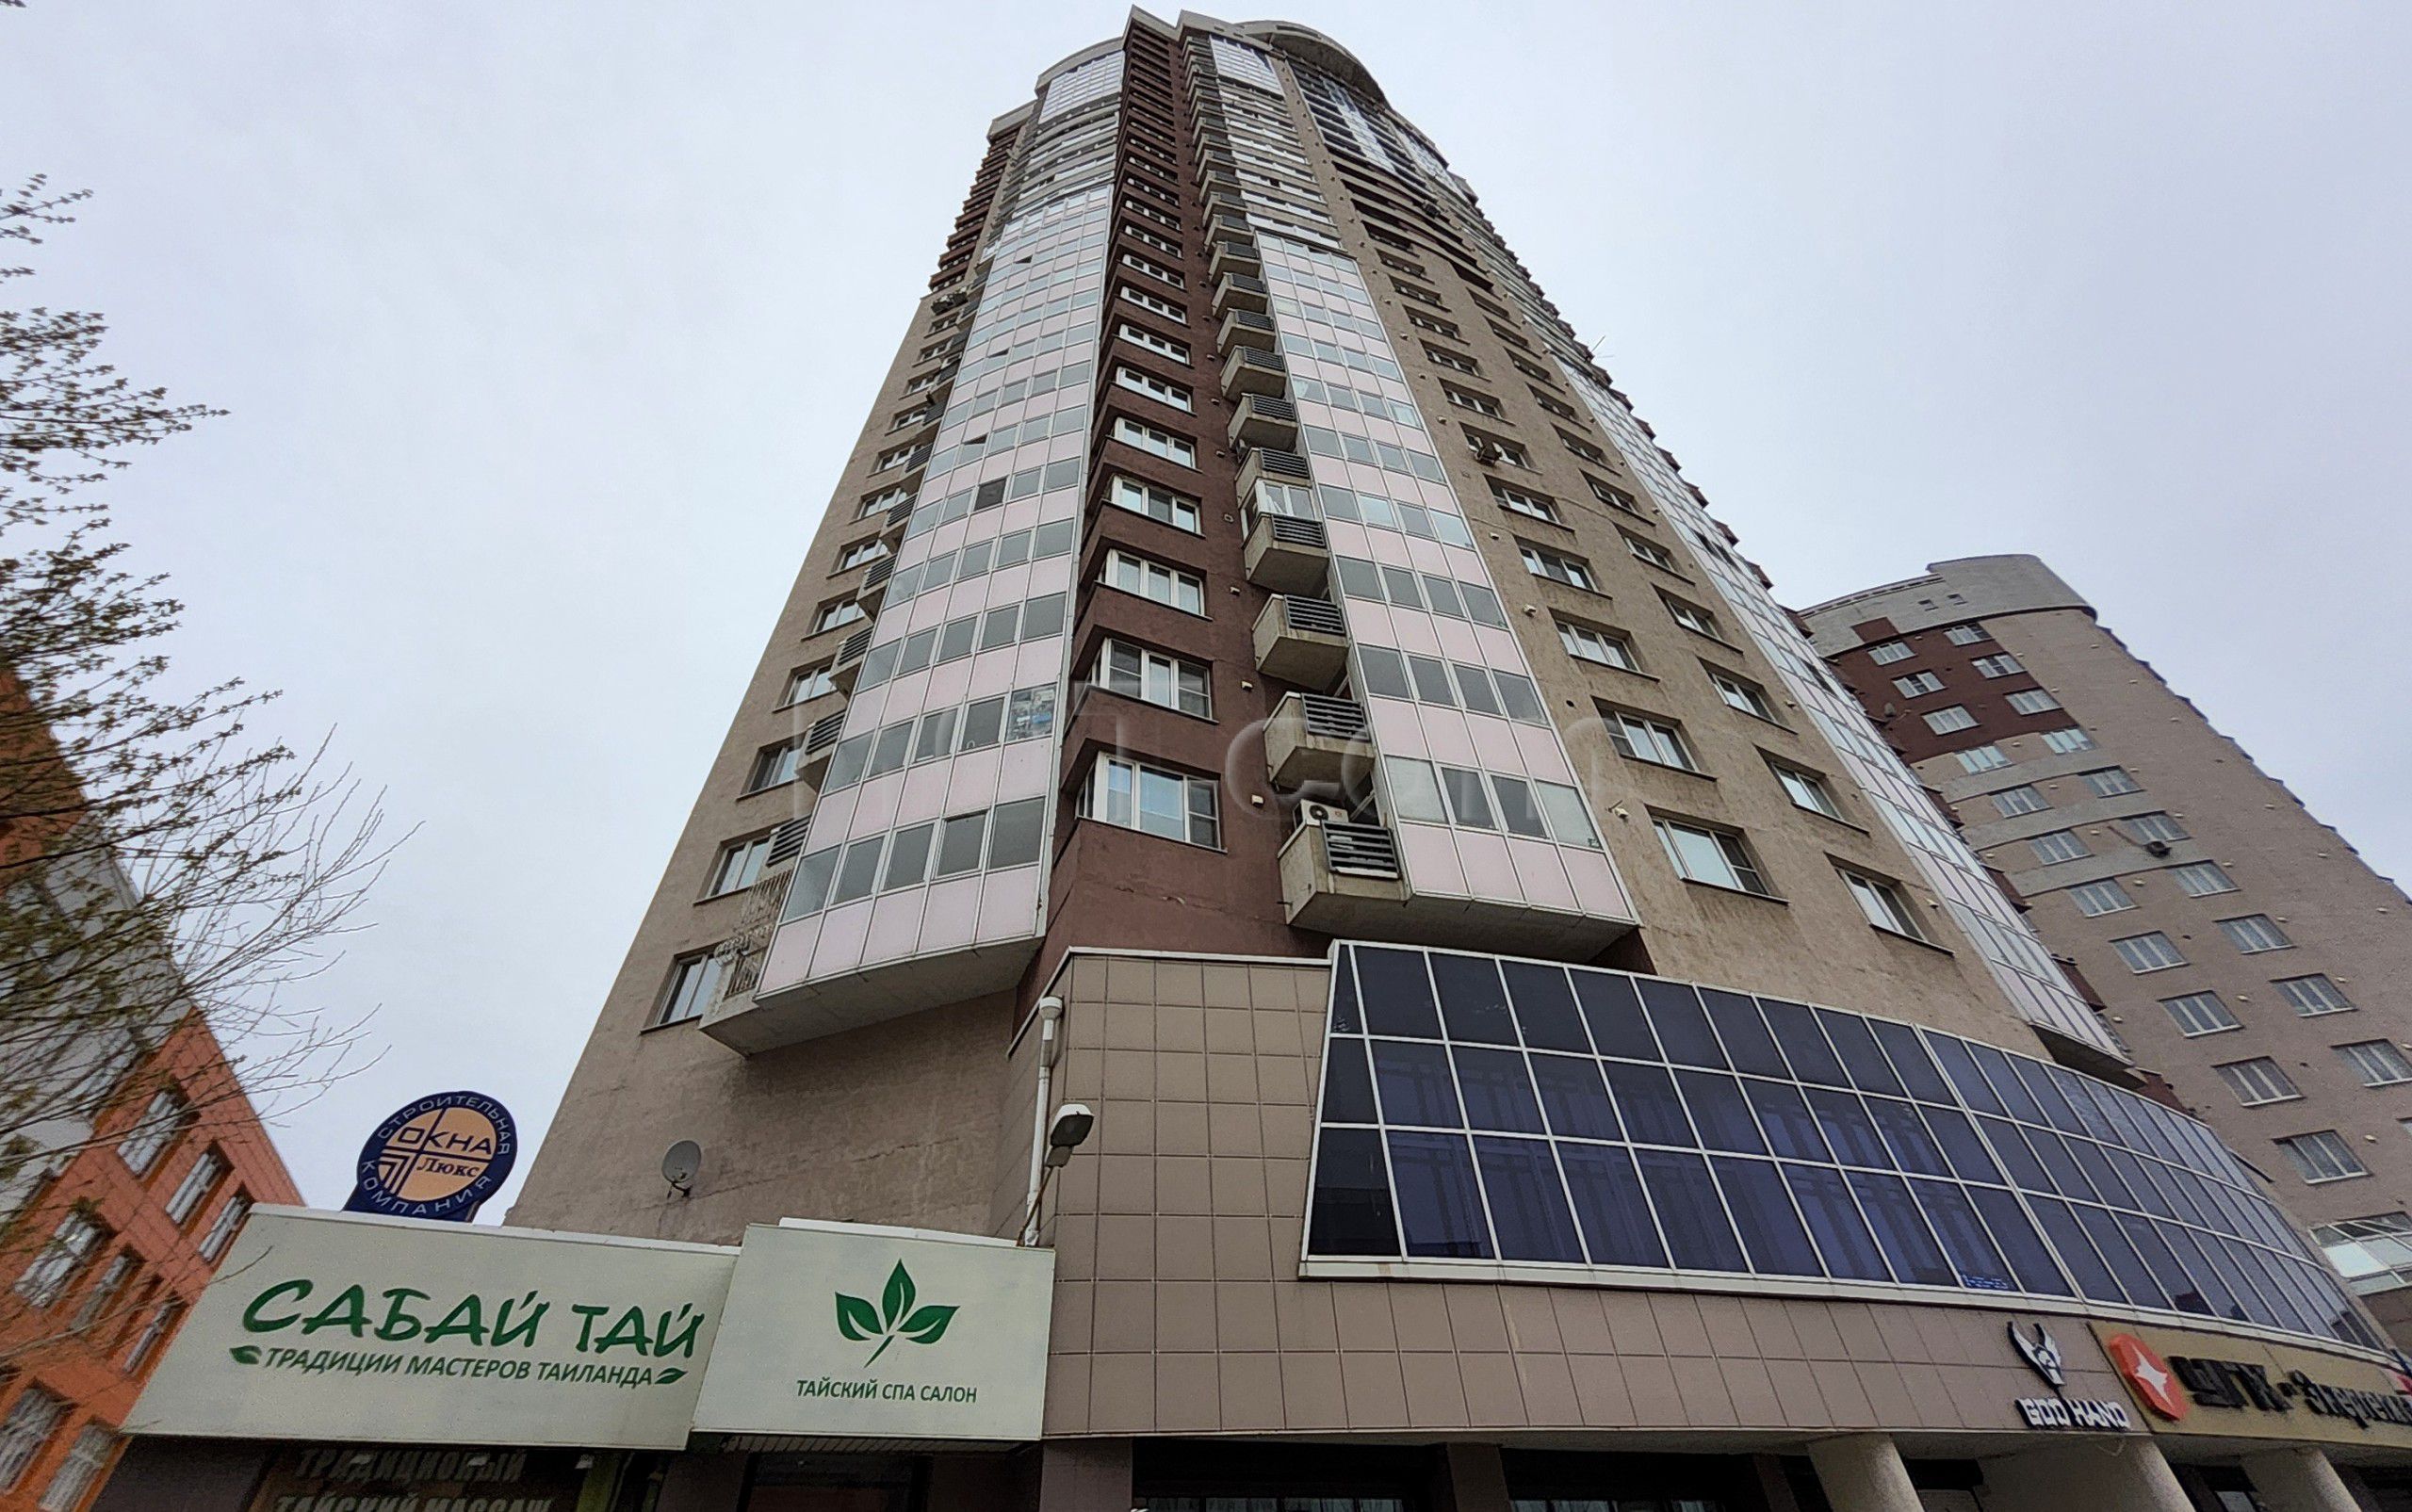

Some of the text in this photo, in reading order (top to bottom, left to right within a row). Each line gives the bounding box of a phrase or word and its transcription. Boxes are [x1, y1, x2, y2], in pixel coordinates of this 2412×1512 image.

[378, 1095, 510, 1155] СТРОИТЕЛЬНАЯ
[398, 1127, 492, 1155] ОКНА
[416, 1157, 481, 1178] Люкс
[362, 1160, 493, 1214] КОМПАНИЯ
[243, 1279, 705, 1358] САБАЙ ТАЙ
[265, 1347, 652, 1389] ТРАДИЦИИ МАСТЕРОВ ТАИЛАНДА
[797, 1376, 977, 1403] ТАЙСКИЙ СПА САЛОН
[2015, 1397, 2130, 1430] GOD HAND
